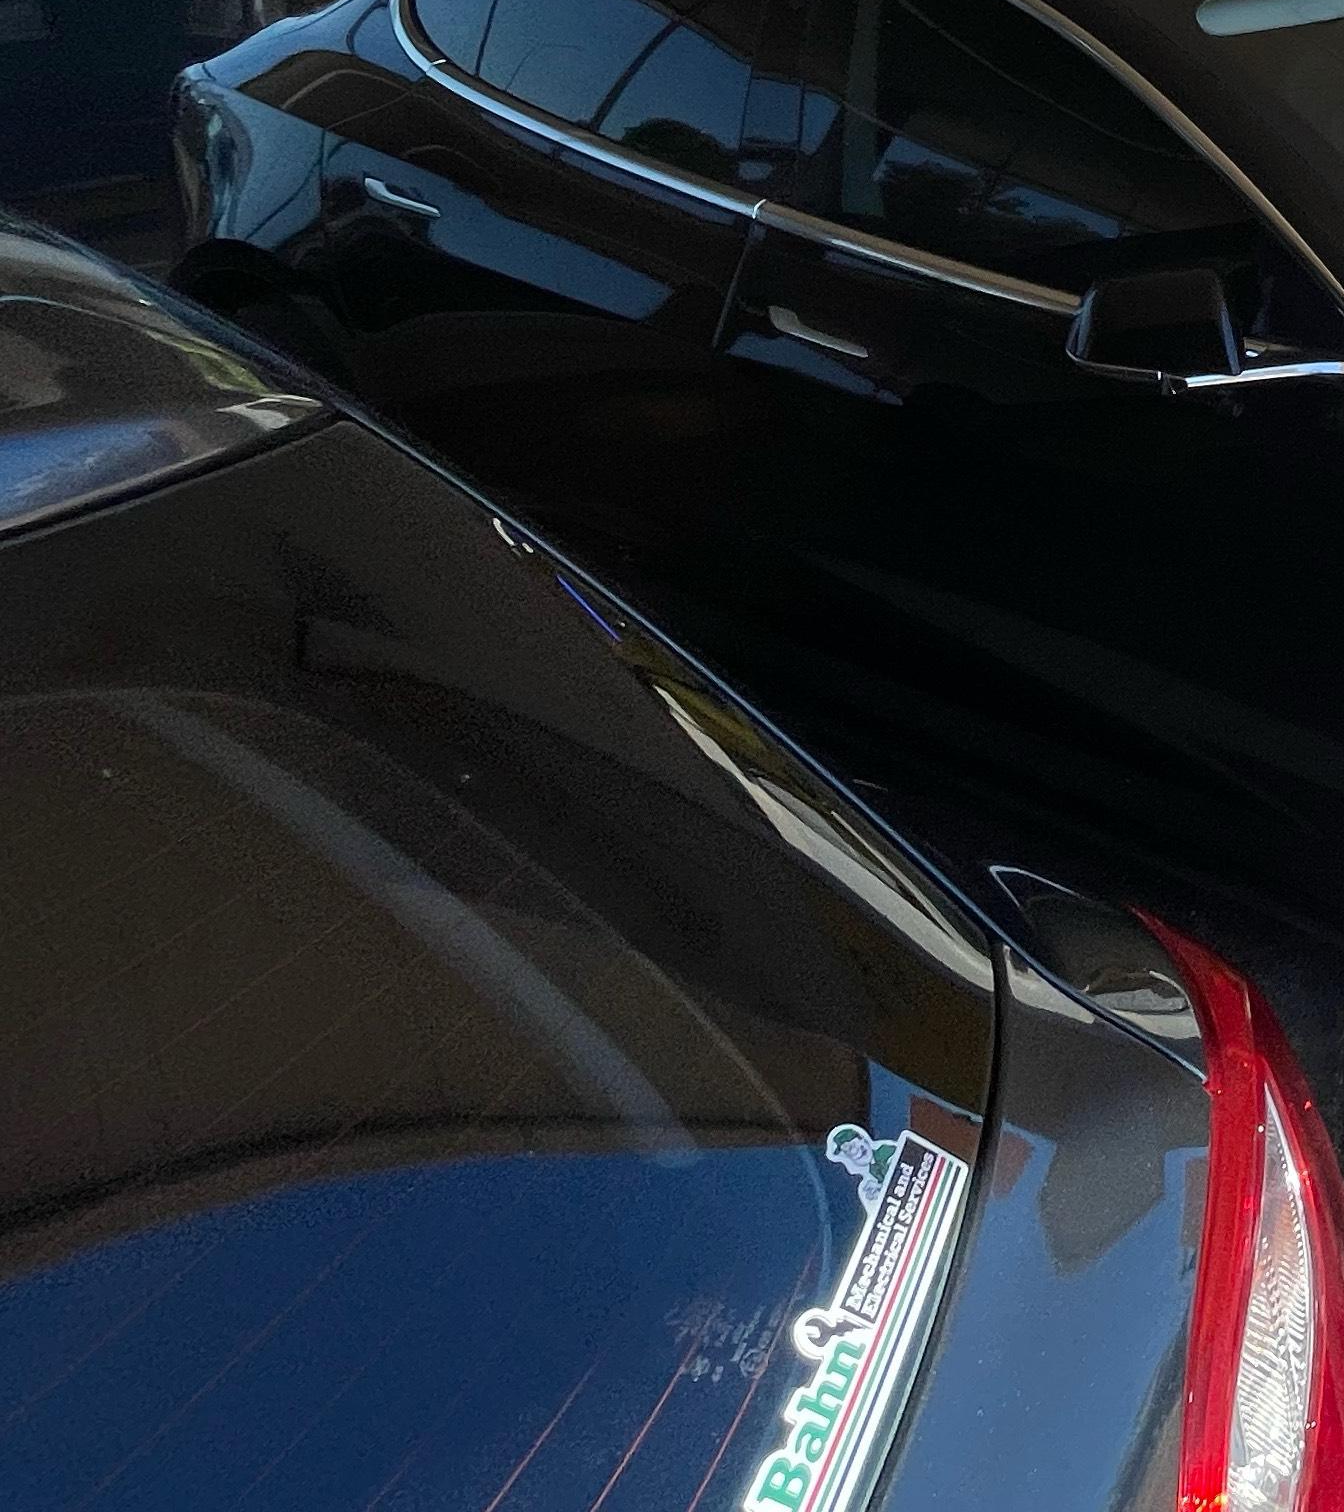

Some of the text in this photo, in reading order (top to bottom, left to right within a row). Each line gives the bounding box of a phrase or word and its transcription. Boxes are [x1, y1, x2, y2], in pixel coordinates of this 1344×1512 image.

[845, 1162, 914, 1312] Mechanical and
[860, 1151, 935, 1320] Electrical Services
[756, 1340, 867, 1512] Bahn
